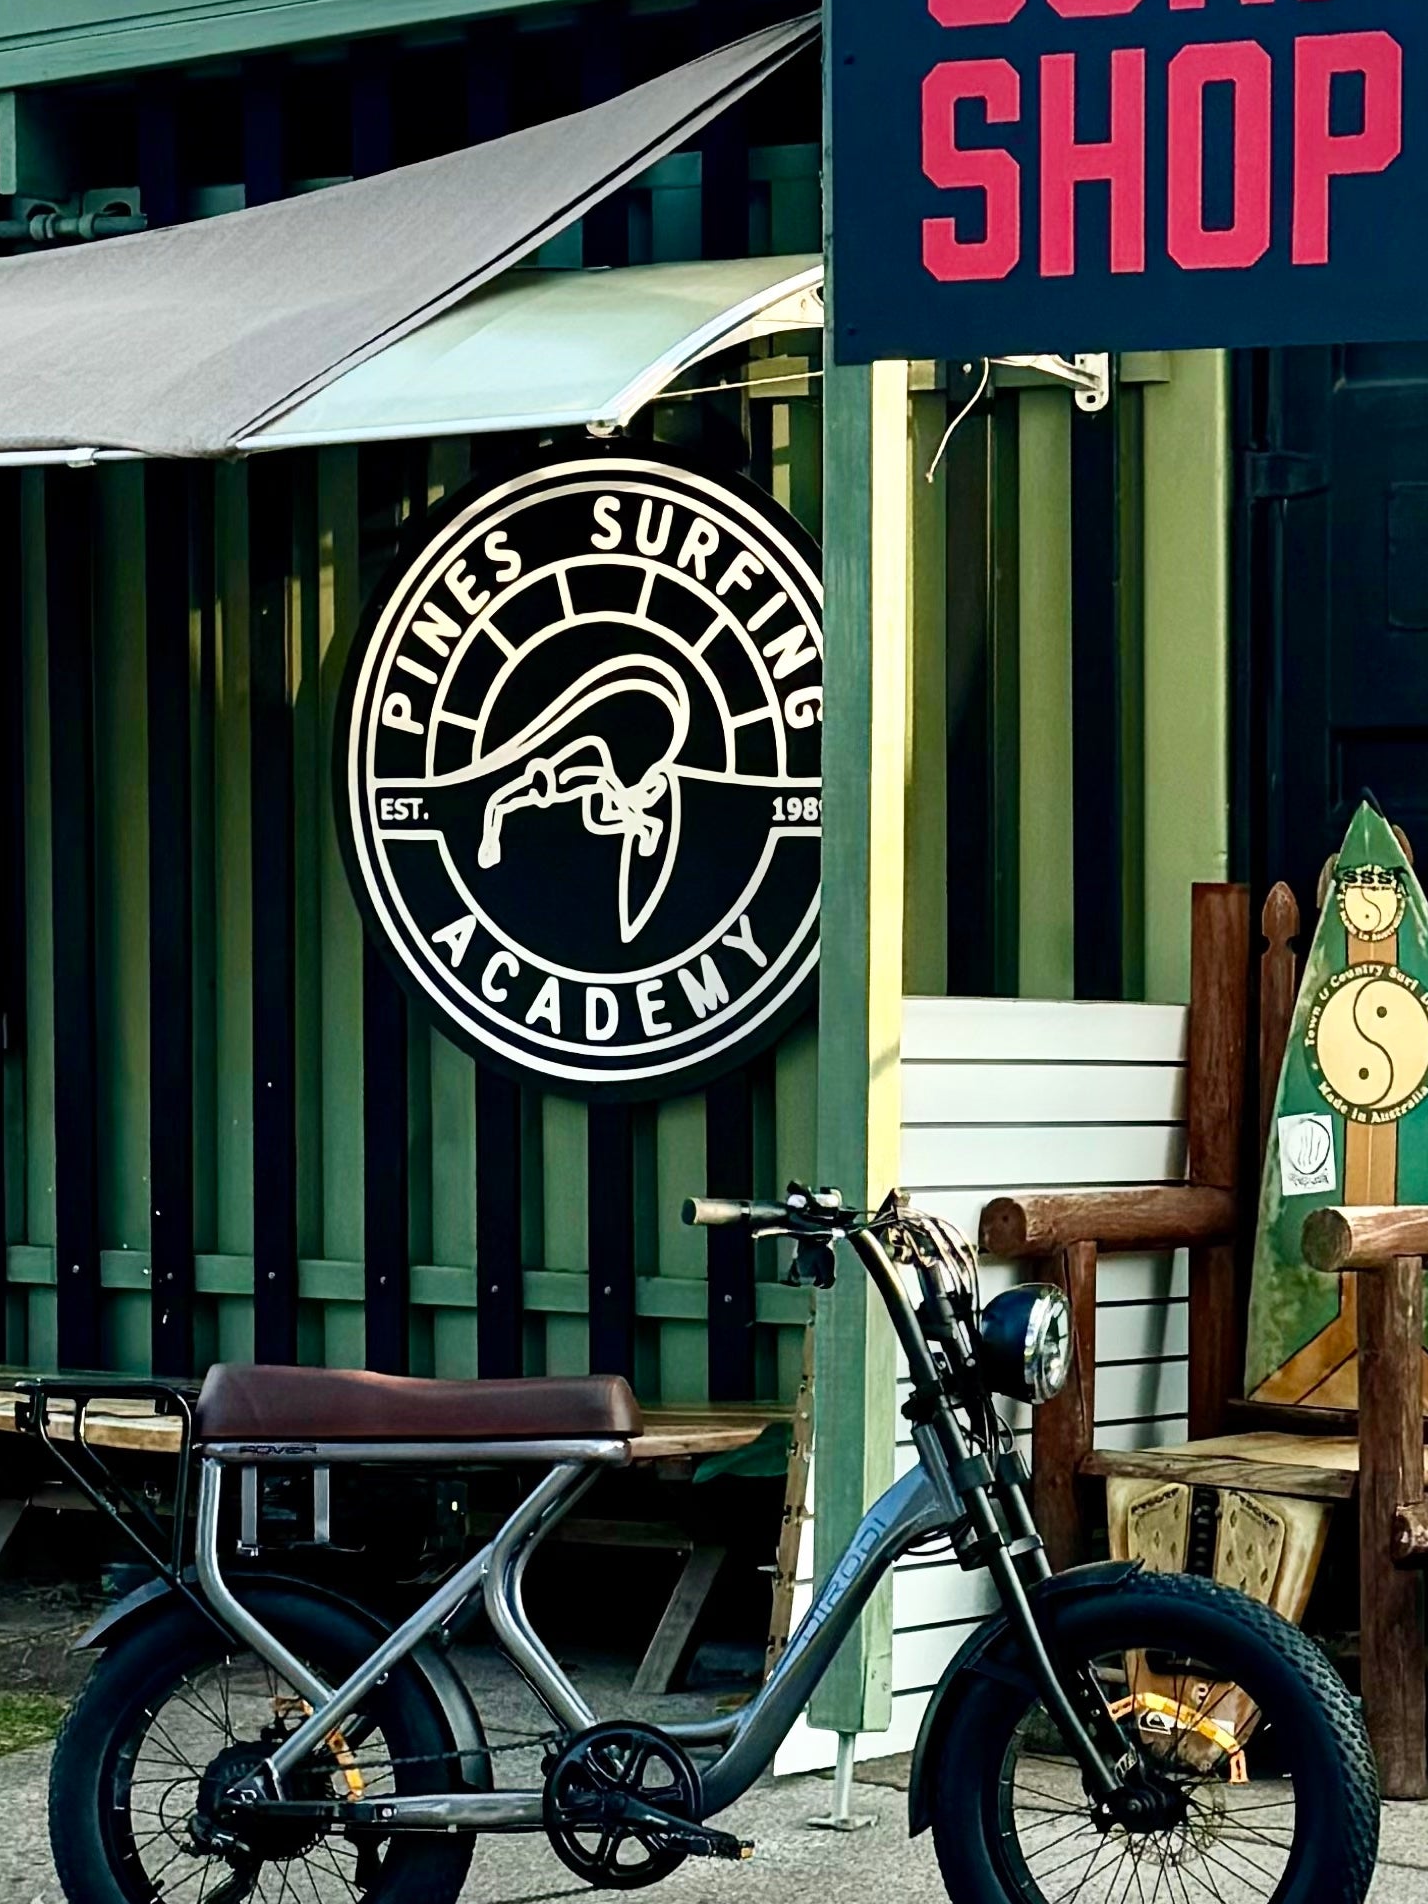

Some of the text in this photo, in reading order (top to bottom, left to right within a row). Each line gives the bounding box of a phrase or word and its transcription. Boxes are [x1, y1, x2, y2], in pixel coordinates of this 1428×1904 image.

[921, 29, 1403, 283] SHOP
[380, 494, 823, 735] PINES SURFING
[379, 797, 823, 822] EST. 198
[431, 914, 769, 1041] ACADEMY
[1304, 1006, 1322, 1047] Town
[1329, 964, 1384, 988] Country
[1388, 966, 1420, 992] Surf
[1318, 1080, 1349, 1114] Made
